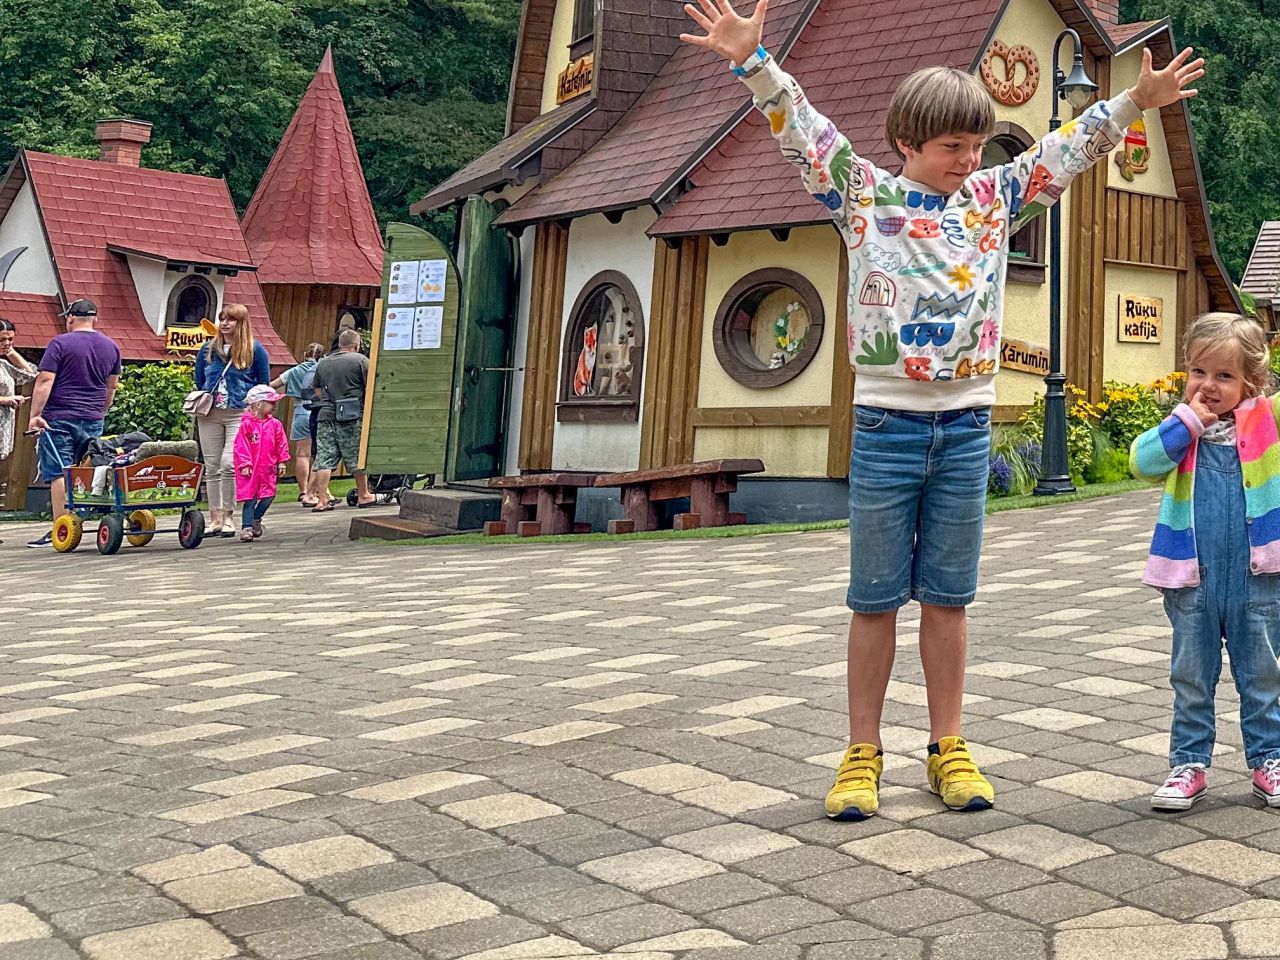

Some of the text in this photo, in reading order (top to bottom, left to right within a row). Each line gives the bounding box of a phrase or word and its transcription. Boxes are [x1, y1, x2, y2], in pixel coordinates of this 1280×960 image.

[1126, 300, 1157, 319] Rūķu
[1125, 321, 1157, 340] kafija
[1001, 342, 1049, 372] Kārumiņ
